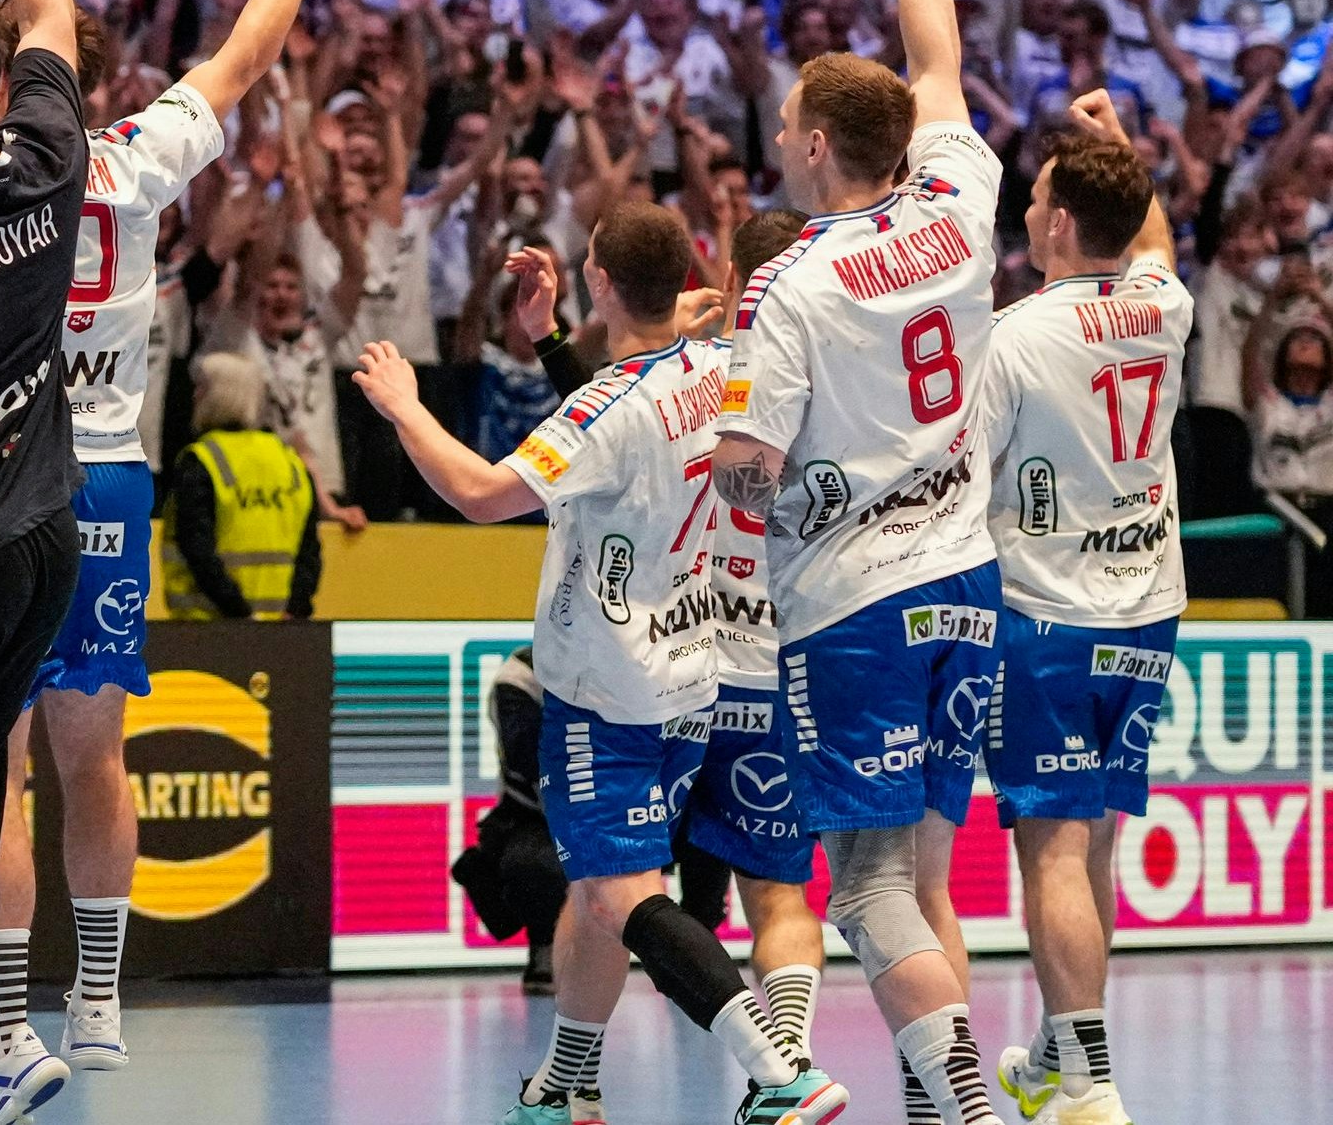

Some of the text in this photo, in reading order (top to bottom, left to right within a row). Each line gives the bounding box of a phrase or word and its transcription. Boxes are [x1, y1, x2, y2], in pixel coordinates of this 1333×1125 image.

[68, 199, 119, 303] 0
[832, 215, 973, 302] MIKKJALSSON
[70, 313, 92, 329] 24
[1076, 299, 1162, 344] AV TEIGUM
[61, 351, 120, 388] WI
[902, 305, 964, 425] 8
[1091, 354, 1167, 463] 17
[1029, 467, 1050, 530] Silikal
[1113, 491, 1147, 509] SPORT
[606, 544, 627, 607] Silikal
[731, 559, 753, 573] 24
[717, 591, 777, 627] WI
[1035, 617, 1053, 636] 17
[80, 636, 137, 656] MAZ
[1147, 651, 1300, 782] QUI
[127, 771, 271, 819] ARTING
[627, 804, 668, 826] BOR
[1117, 794, 1310, 922] OLY
